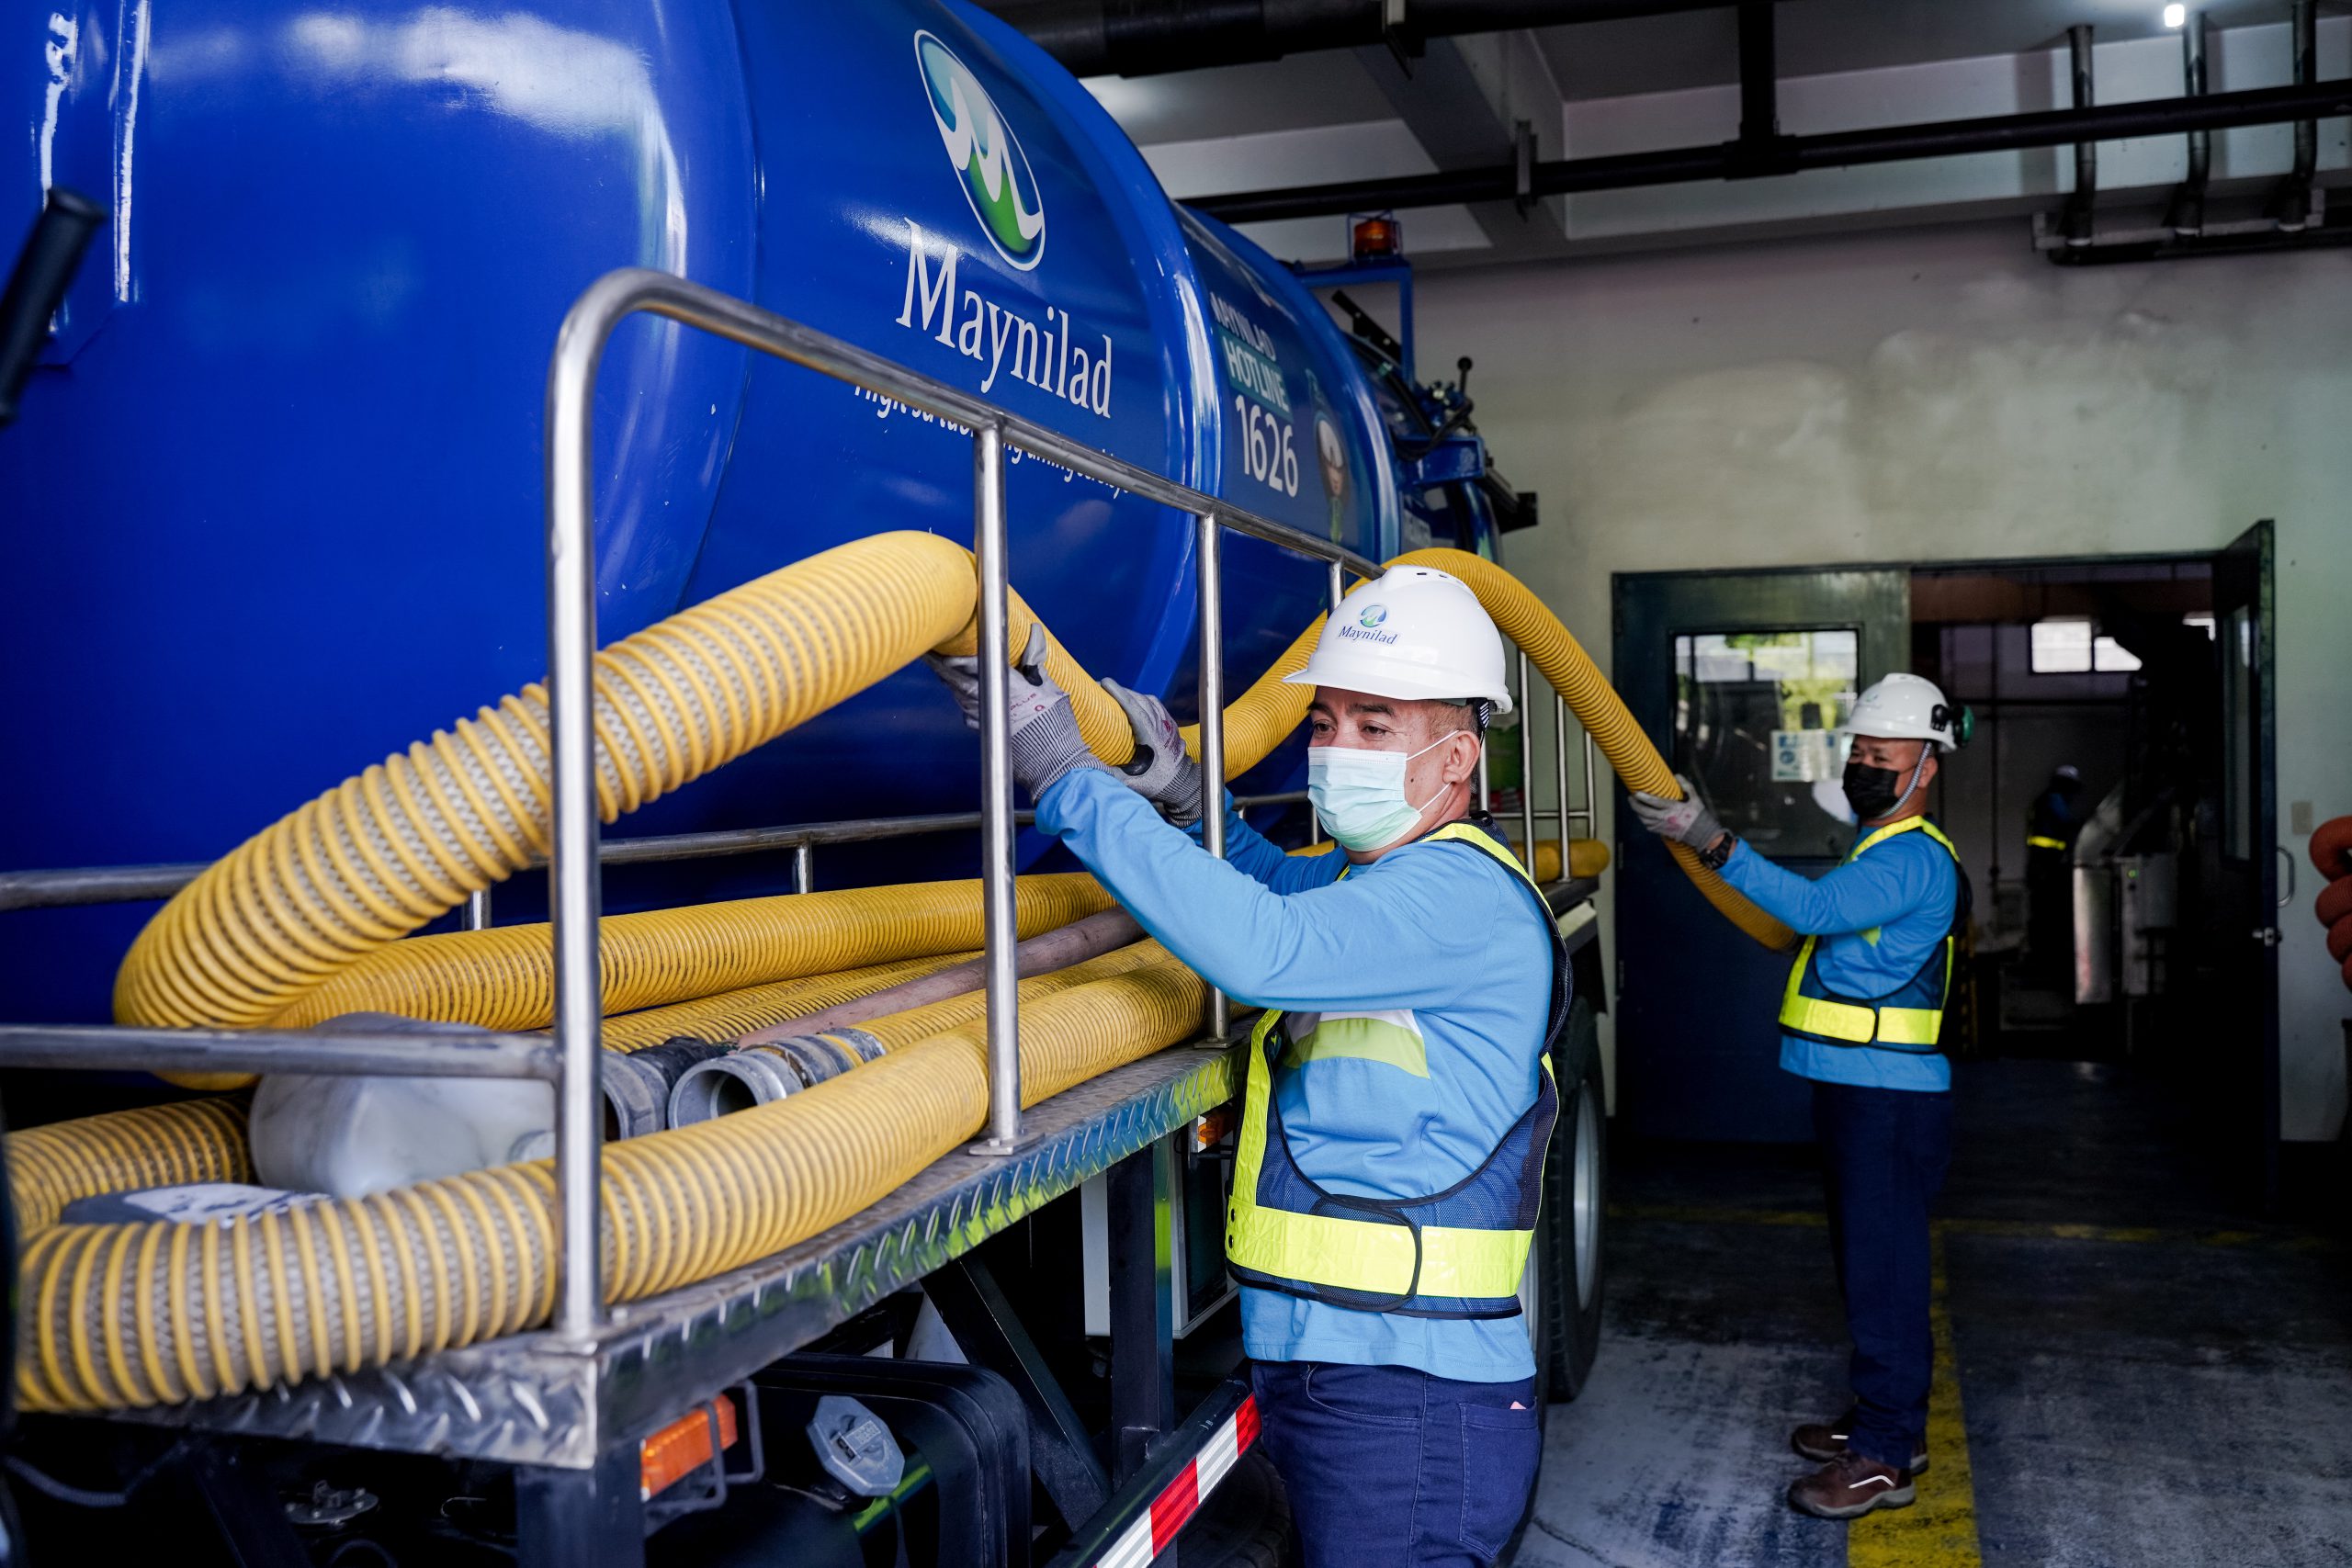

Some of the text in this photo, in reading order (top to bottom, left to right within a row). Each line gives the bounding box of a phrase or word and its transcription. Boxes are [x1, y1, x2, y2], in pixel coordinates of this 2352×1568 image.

[896, 217, 1112, 419] Maynilad
[1222, 335, 1290, 412] HOTLINE
[1235, 394, 1299, 498] 1626
[1338, 626, 1398, 645] Maynilad
